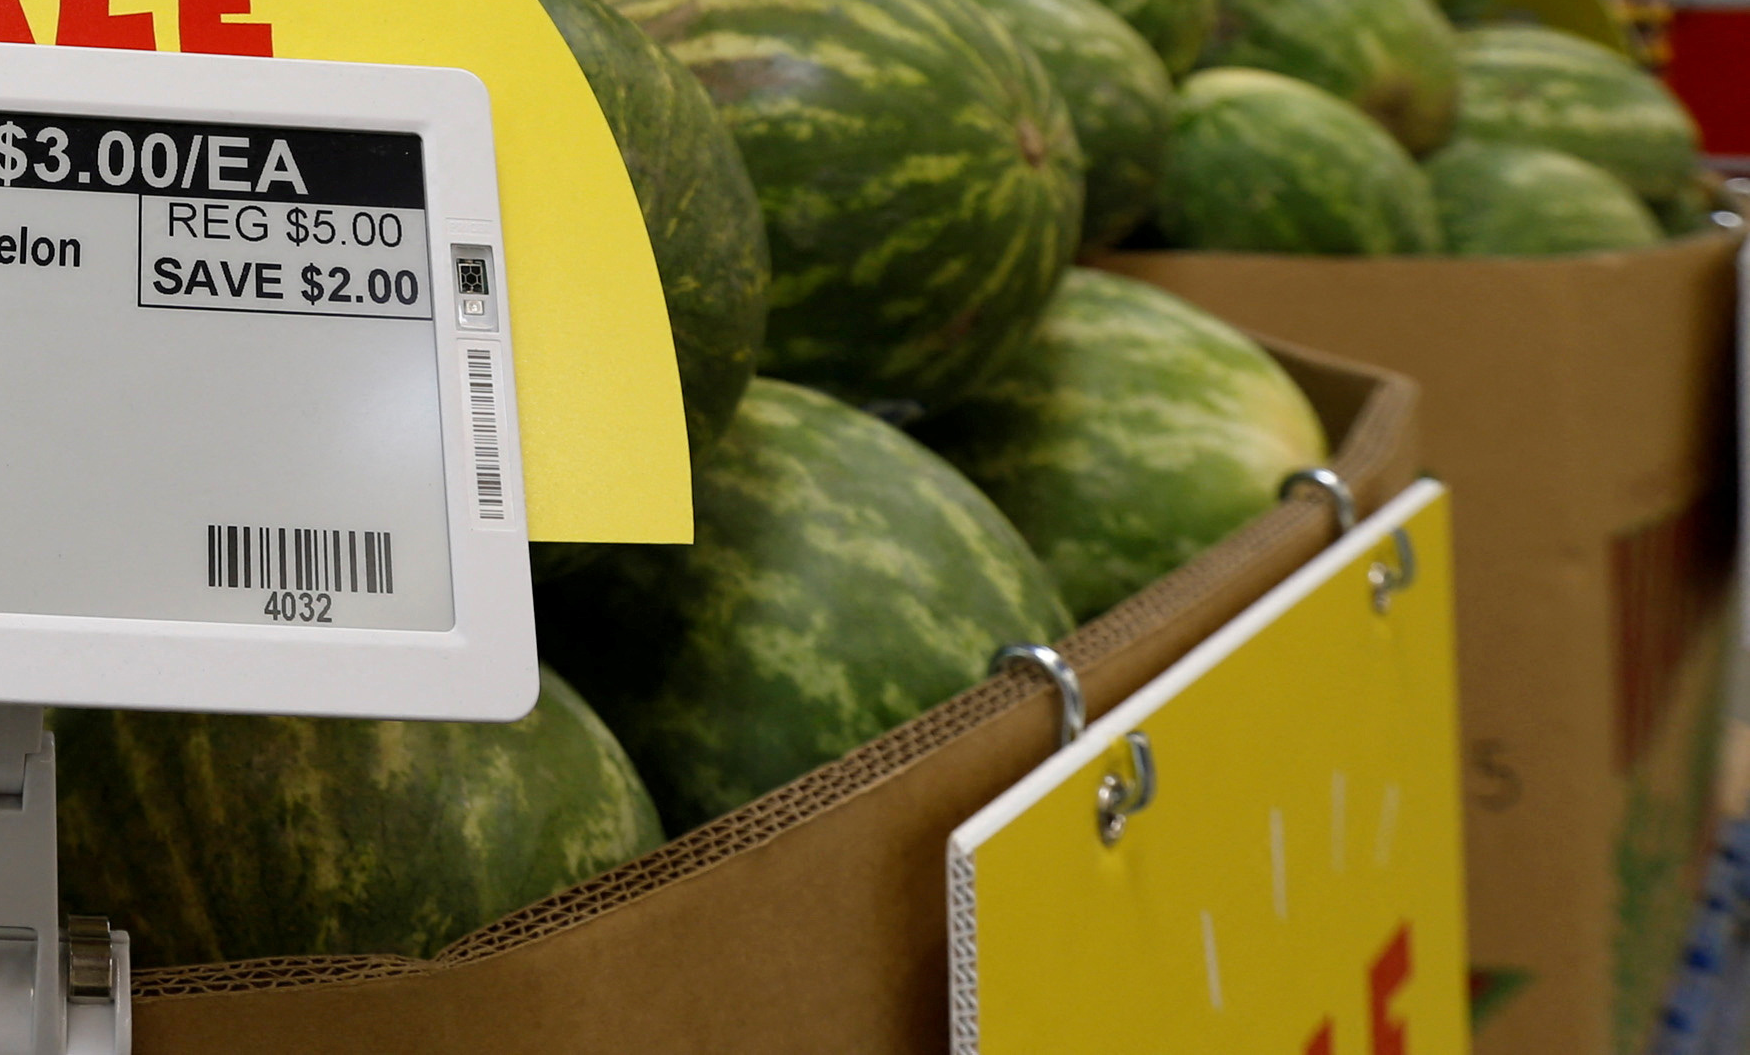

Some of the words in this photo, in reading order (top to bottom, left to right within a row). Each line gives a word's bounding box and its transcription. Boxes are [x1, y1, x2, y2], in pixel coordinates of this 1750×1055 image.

[168, 202, 269, 243] REG
[286, 206, 403, 249] $5.00
[152, 256, 284, 300] SAVE
[300, 262, 419, 307] $2.00
[263, 590, 333, 623] 4032
